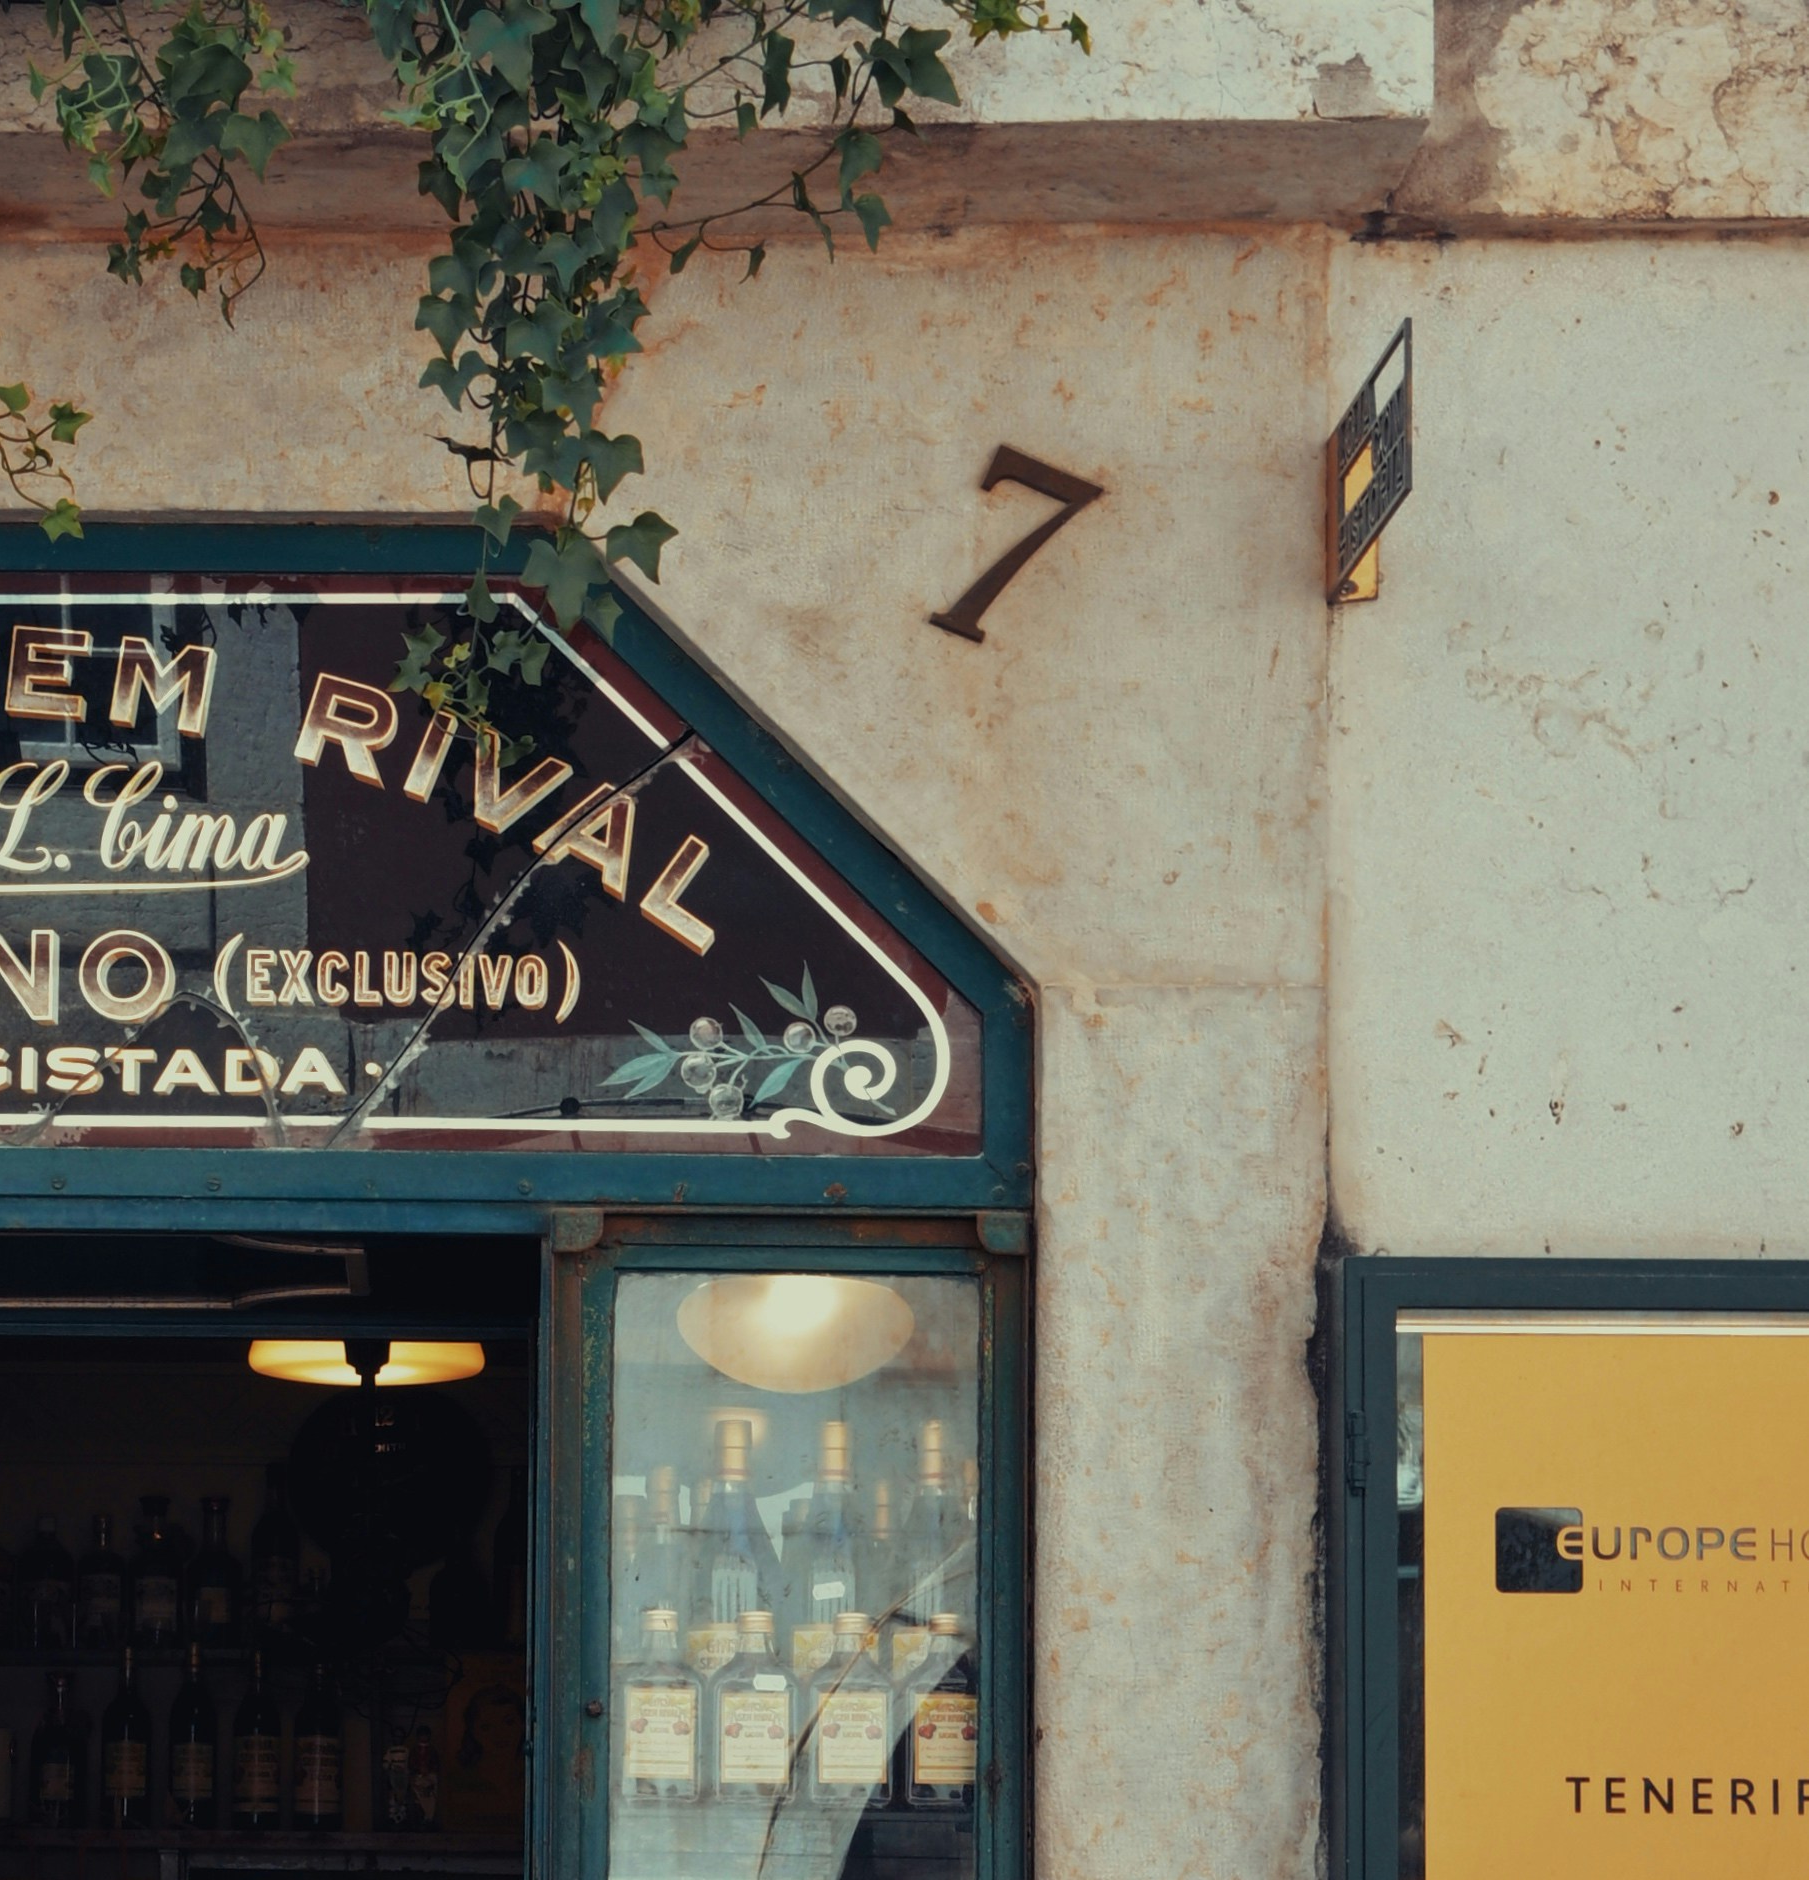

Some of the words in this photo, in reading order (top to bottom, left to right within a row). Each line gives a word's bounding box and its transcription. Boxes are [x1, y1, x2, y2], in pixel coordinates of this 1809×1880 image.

[928, 443, 1101, 643] 7
[84, 760, 310, 875] Cima
[294, 671, 716, 958] RIVAL
[214, 930, 583, 1024] (EXCLUSIVO)
[1555, 1526, 1757, 1562] EUROPE
[1770, 1527, 1809, 1562] H
